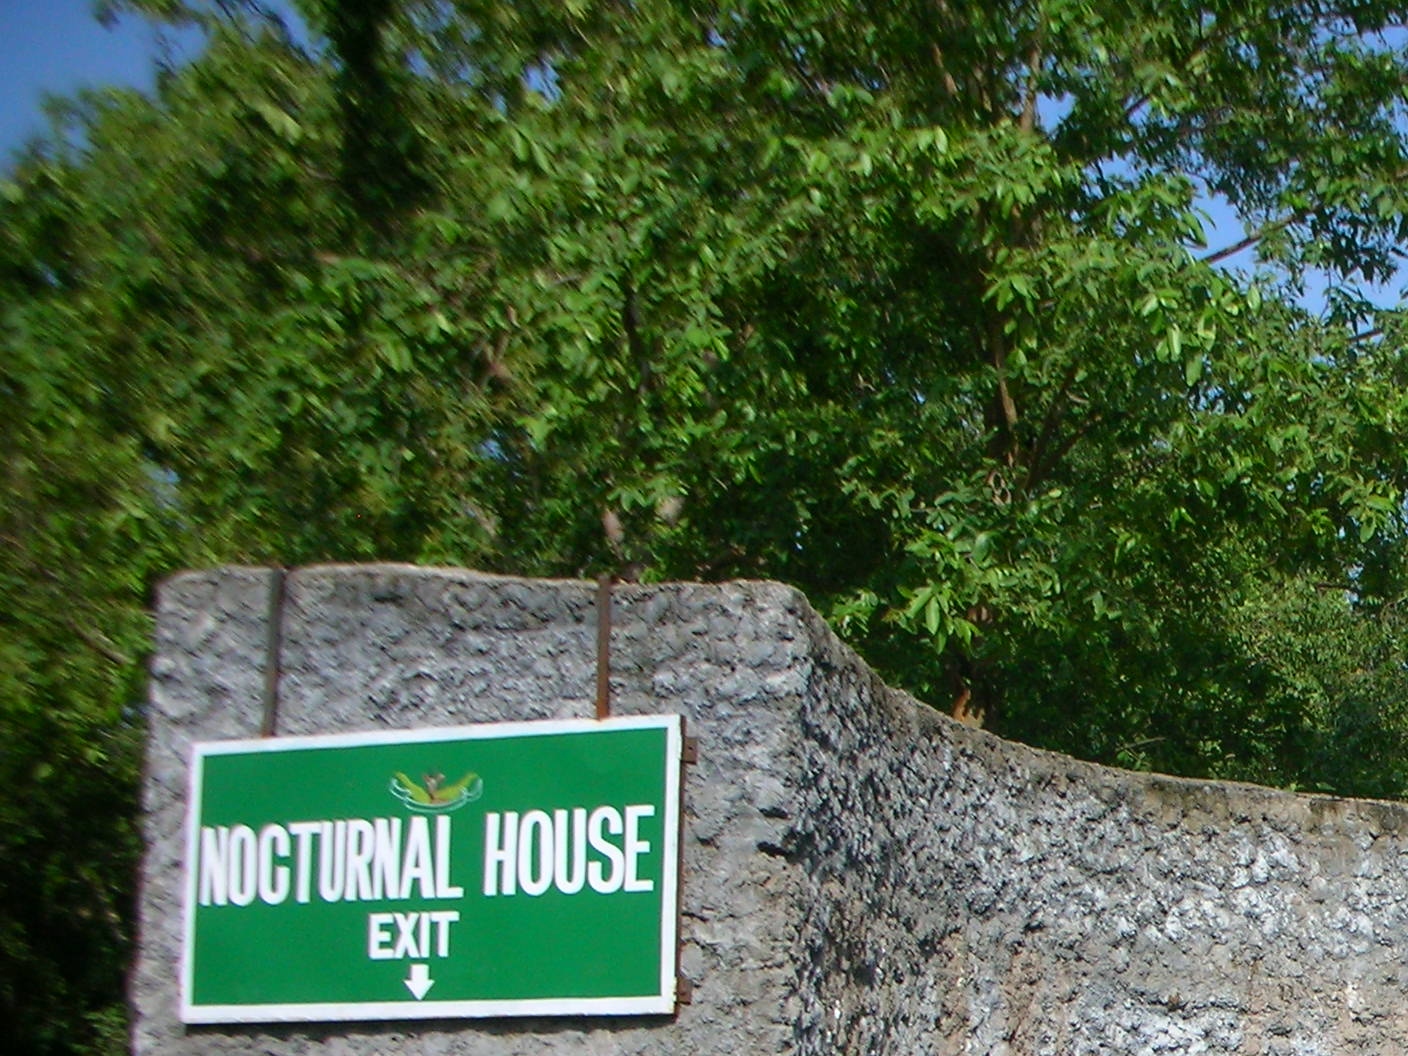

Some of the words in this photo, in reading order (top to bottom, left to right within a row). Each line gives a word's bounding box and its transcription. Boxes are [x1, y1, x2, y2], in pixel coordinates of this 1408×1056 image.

[199, 815, 463, 906] NOCTURNAL
[483, 805, 655, 896] HOUSE
[368, 911, 460, 960] EXIT
